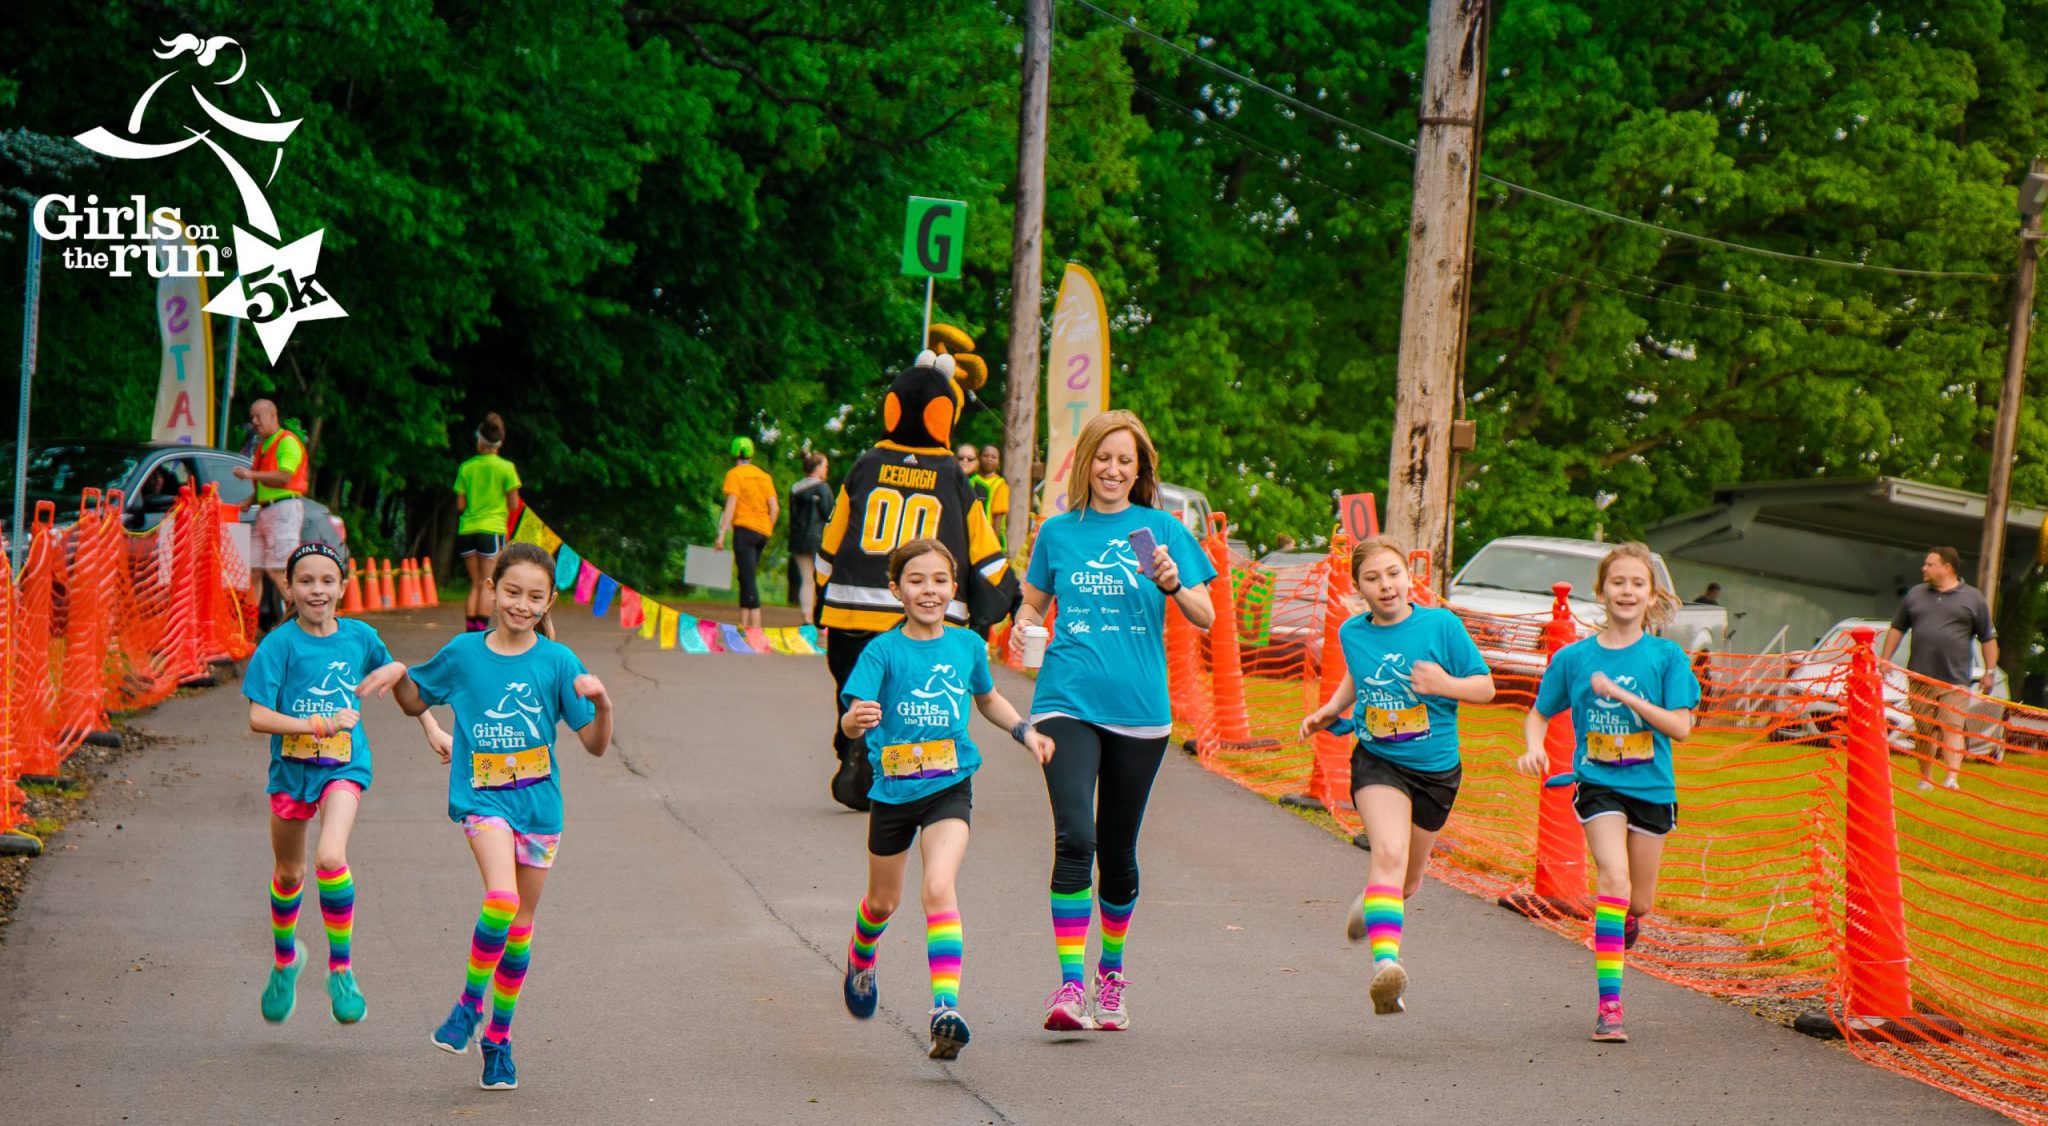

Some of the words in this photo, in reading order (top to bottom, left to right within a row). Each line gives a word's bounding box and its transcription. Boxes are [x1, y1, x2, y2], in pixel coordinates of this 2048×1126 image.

[916, 205, 951, 274] G
[878, 463, 938, 490] ICEBURGH
[1070, 571, 1114, 585] Girls
[1092, 584, 1126, 595] run
[292, 698, 334, 713] Girls
[897, 701, 939, 717] Girls
[917, 715, 949, 727] run
[1586, 708, 1620, 725] Girls
[473, 722, 513, 738] Girls
[479, 738, 491, 747] the
[491, 737, 527, 749] run
[509, 772, 517, 788] 1
